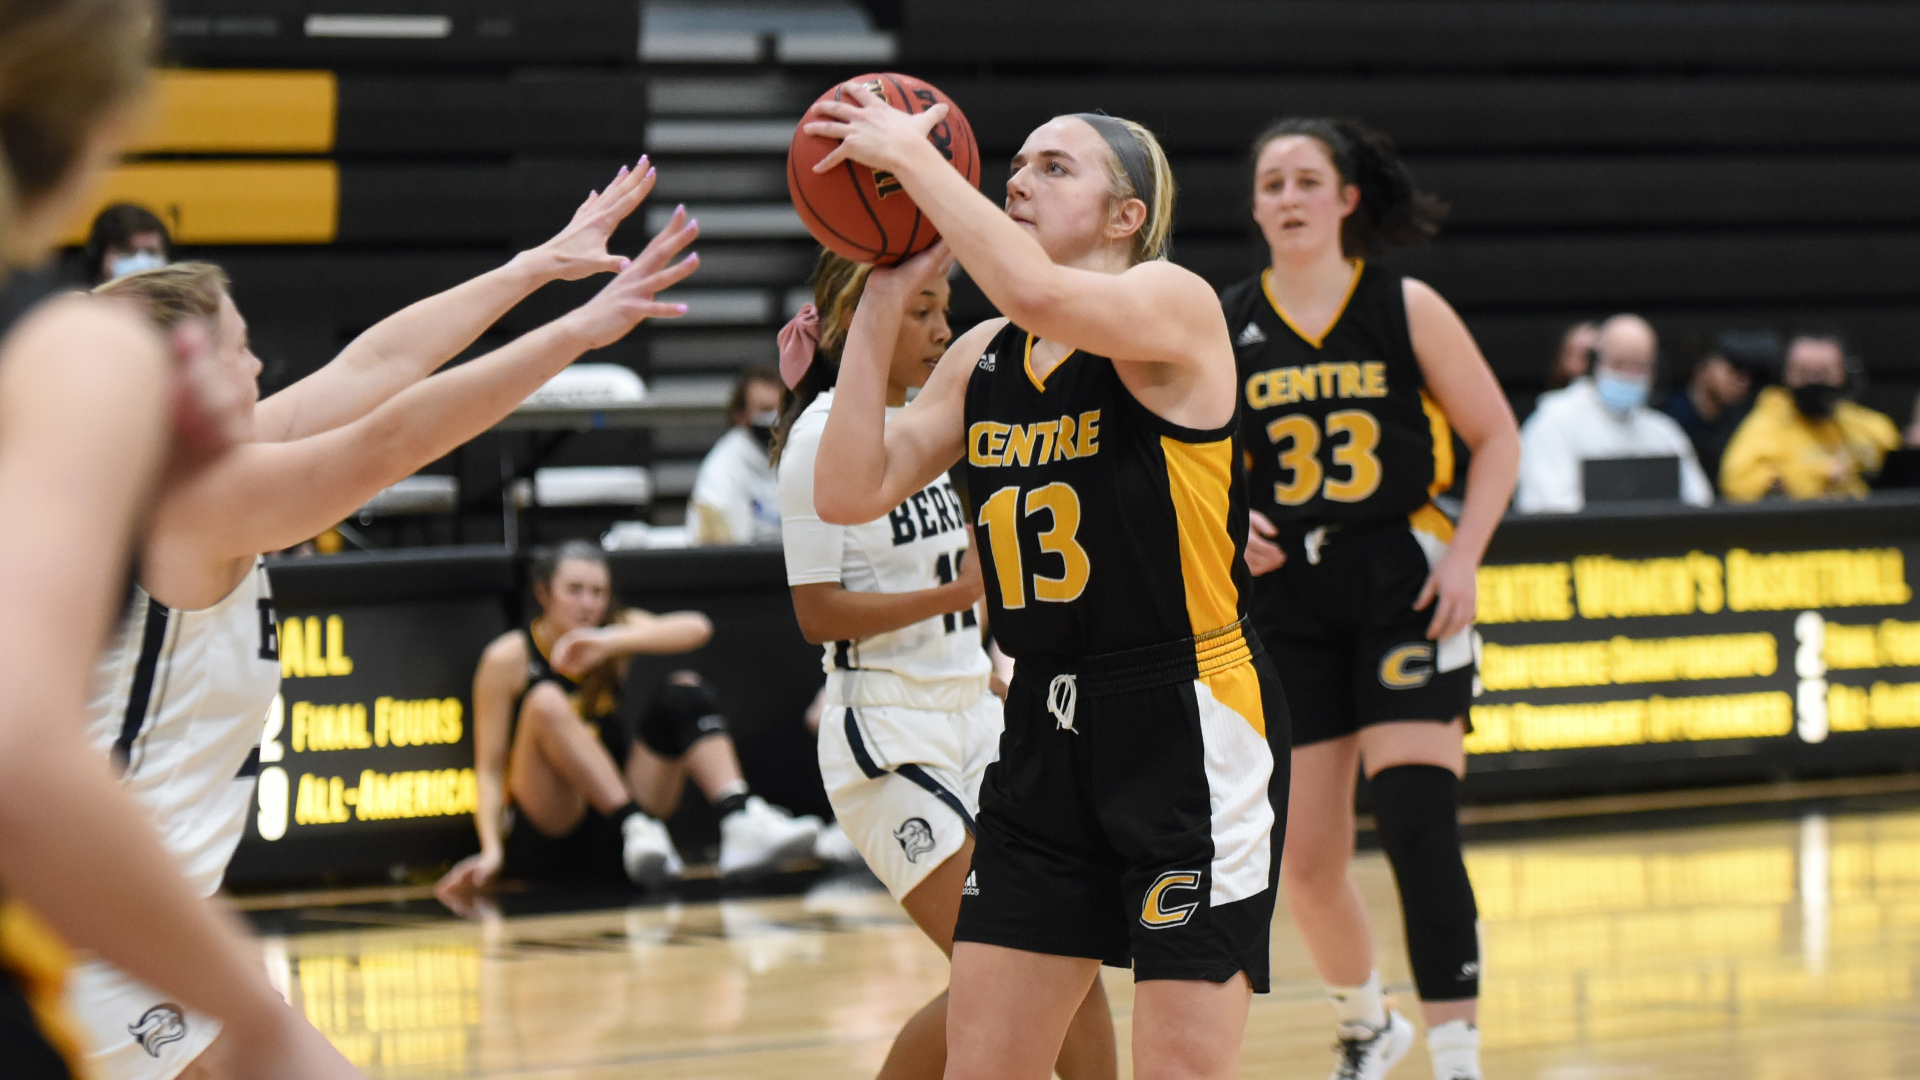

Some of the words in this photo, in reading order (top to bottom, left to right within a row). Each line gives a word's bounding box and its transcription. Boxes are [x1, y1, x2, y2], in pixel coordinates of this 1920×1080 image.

[1245, 360, 1388, 411] CENTRE
[968, 408, 1101, 468] CENTRE
[1266, 408, 1383, 506] 33
[977, 481, 1090, 610] 13
[276, 614, 354, 679] ALL
[291, 699, 374, 753] FINAL
[372, 695, 464, 748] FOURS
[256, 765, 290, 842] 9
[1139, 870, 1201, 930] C
